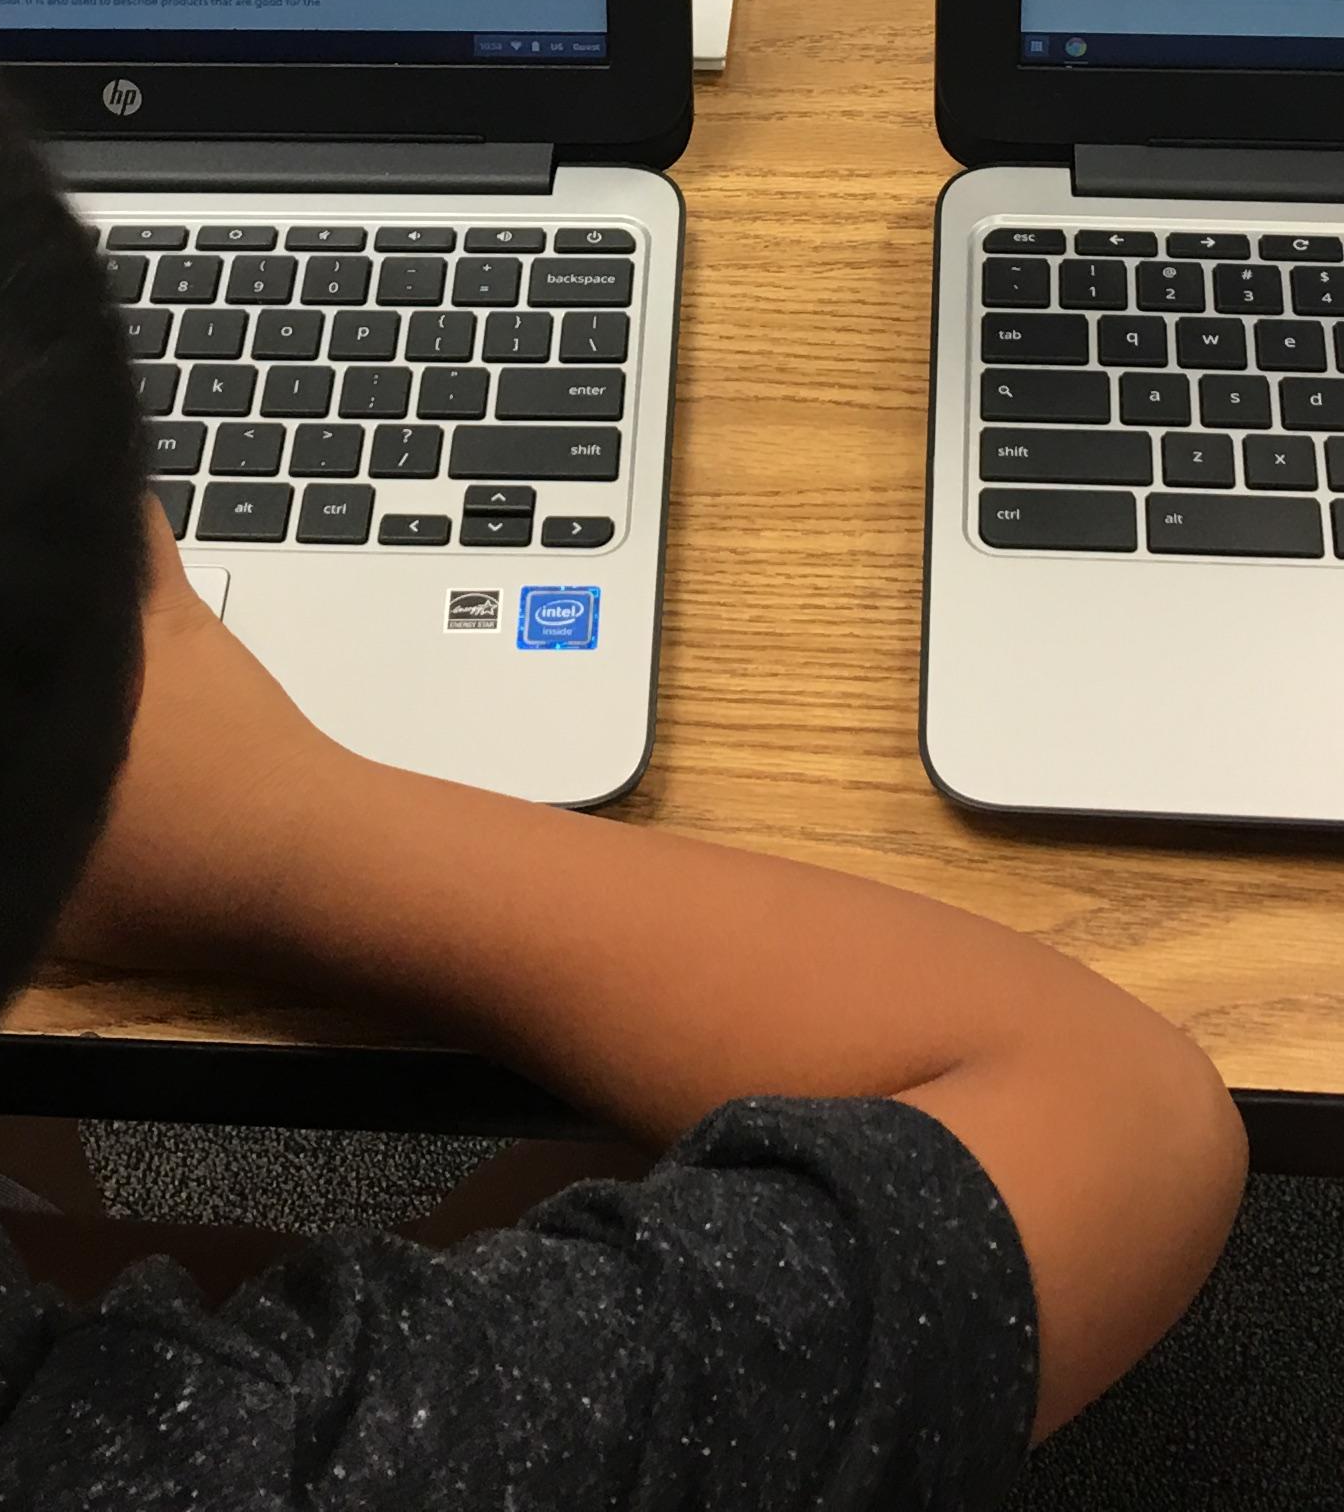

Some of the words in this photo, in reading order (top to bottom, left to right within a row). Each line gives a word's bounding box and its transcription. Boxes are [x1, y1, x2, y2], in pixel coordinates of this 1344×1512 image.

[107, 79, 139, 115] hp
[548, 274, 615, 285] backspace
[358, 327, 369, 340] p
[999, 330, 1021, 339] tab
[1127, 333, 1138, 345] q
[1203, 335, 1218, 344] w
[569, 387, 606, 395] enter
[1150, 391, 1160, 401] a
[1311, 393, 1322, 405] d
[158, 439, 176, 449] m
[571, 445, 600, 455] shift
[999, 447, 1028, 457] shift
[235, 503, 252, 512] alt
[324, 504, 346, 514] ctrl
[997, 509, 1019, 519] ctrl
[1165, 514, 1182, 523] alt
[542, 605, 576, 618] intel
[542, 627, 572, 636] inside
